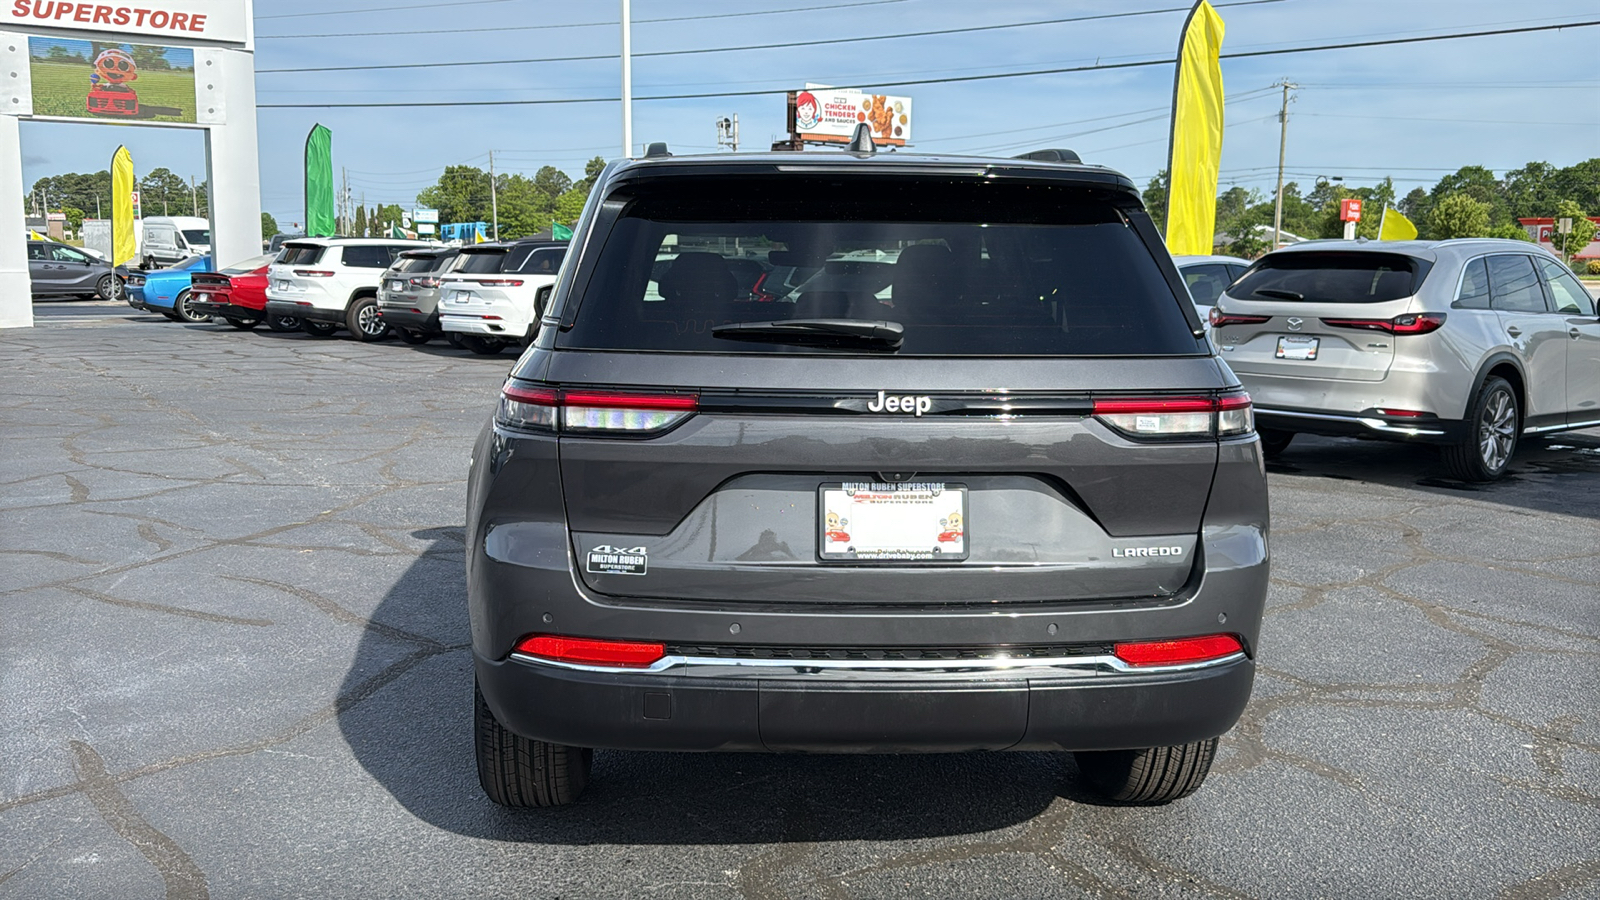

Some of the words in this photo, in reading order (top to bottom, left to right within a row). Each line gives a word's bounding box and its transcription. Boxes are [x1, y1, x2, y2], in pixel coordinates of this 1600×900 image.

[12, 0, 207, 32] SUPERSTORE
[824, 103, 856, 111] CHICKEN
[825, 110, 856, 118] TENDERS
[868, 391, 931, 416] Jeep
[842, 482, 869, 491] MILTON
[871, 482, 896, 491] RUBEN
[897, 482, 945, 491] SUPERSTORE
[592, 545, 647, 555] 4x4
[1112, 546, 1182, 558] LAREDO
[591, 554, 618, 563] MILTON
[619, 555, 644, 565] RUBEN
